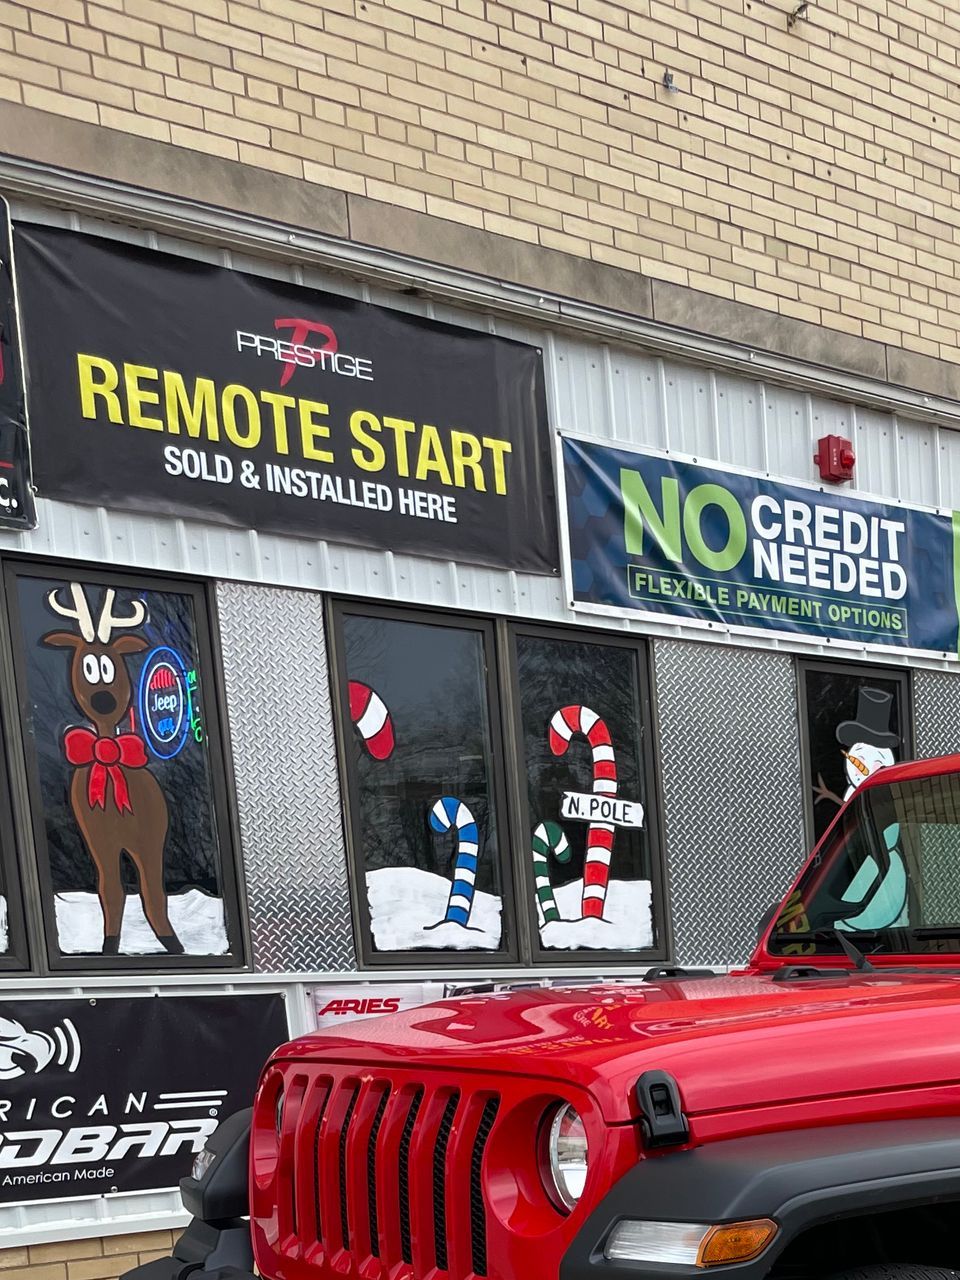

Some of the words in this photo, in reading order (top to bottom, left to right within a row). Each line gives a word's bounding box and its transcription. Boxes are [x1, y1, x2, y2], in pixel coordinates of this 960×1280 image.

[237, 331, 374, 381] PRESTIGE
[77, 353, 334, 463] REMOTE
[350, 410, 512, 495] START
[164, 445, 233, 485] SOLD
[240, 460, 261, 490] &
[265, 464, 393, 512] INSTALLED
[399, 487, 458, 523] HERE
[620, 468, 747, 572] NO
[751, 494, 905, 561] CREDIT
[752, 538, 908, 600] NEEDED
[635, 572, 730, 606] FLEXIBLE
[736, 589, 823, 622] PAYMENT
[828, 604, 902, 630] OPTIONS
[151, 693, 178, 712] Jeep
[568, 796, 584, 816] N.
[590, 798, 634, 824] POLE
[319, 998, 401, 1015] ARIES
[0, 1118, 219, 1168] DBAR
[2, 1172, 71, 1186] American
[73, 1167, 115, 1180] Made
